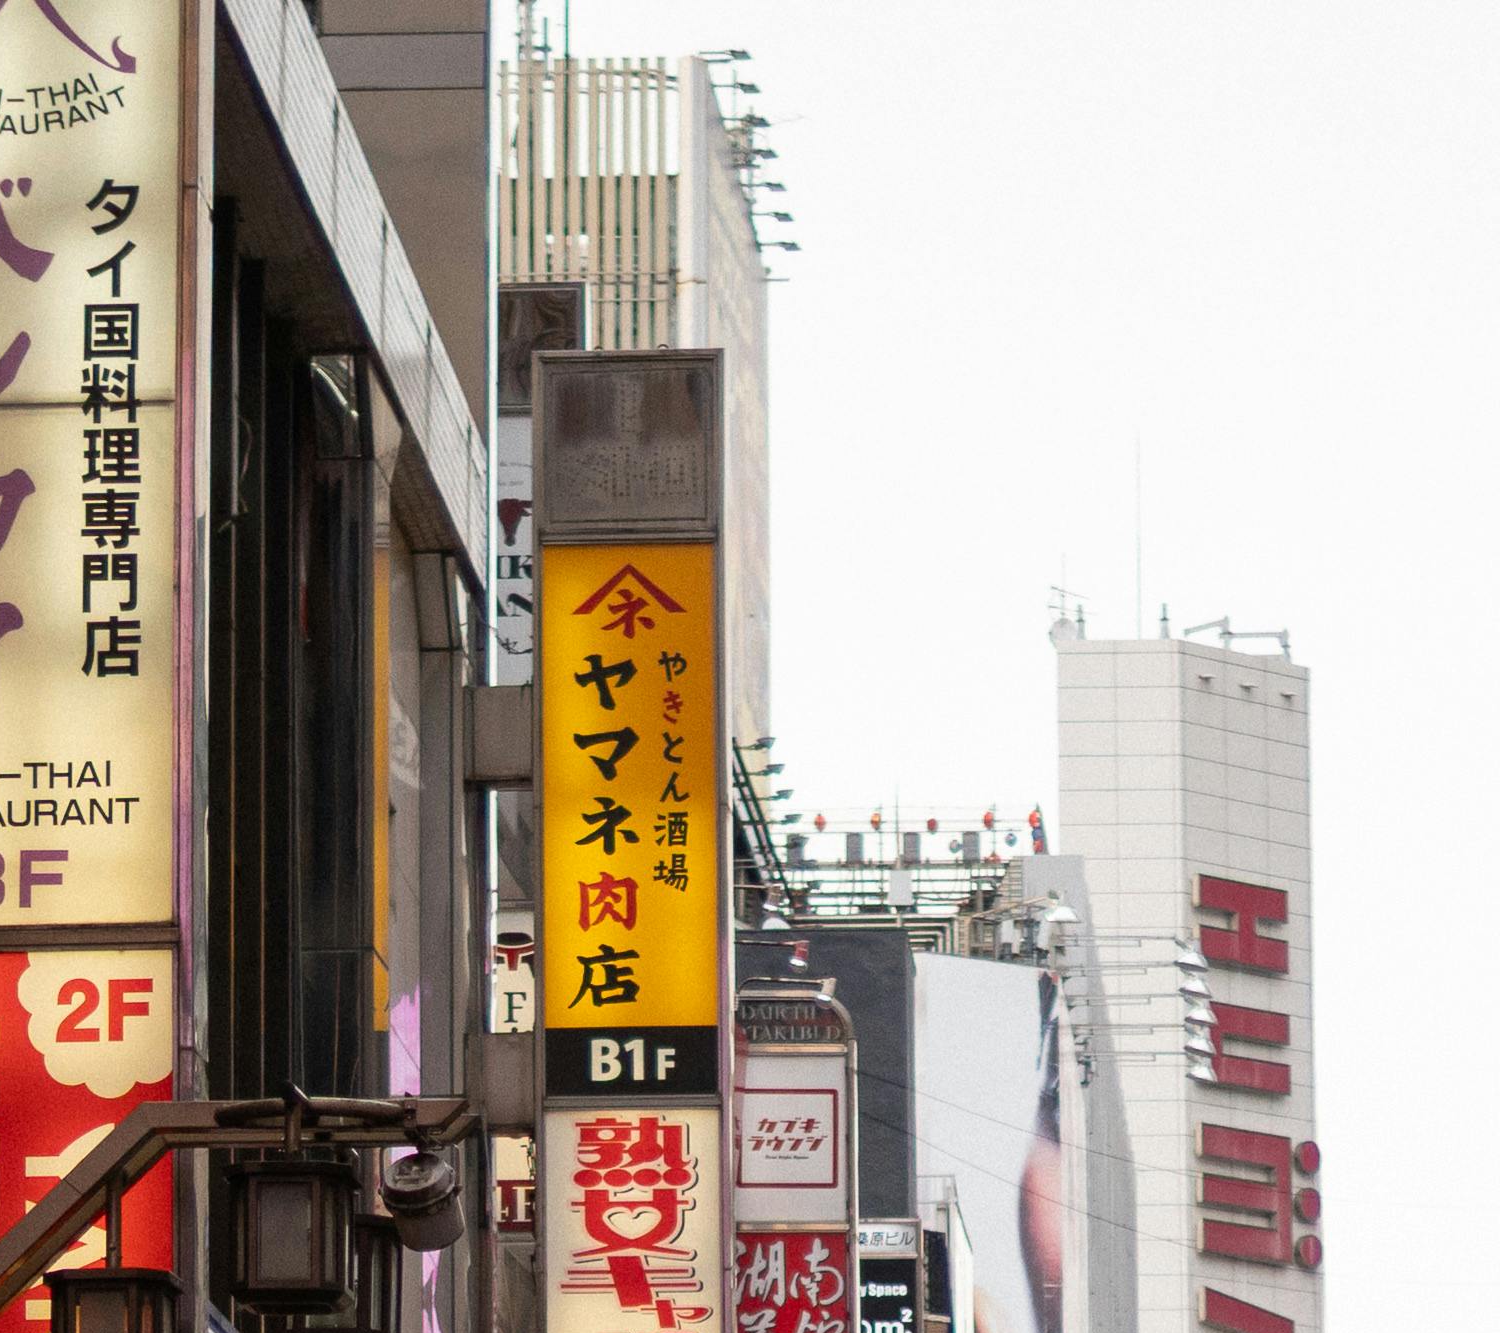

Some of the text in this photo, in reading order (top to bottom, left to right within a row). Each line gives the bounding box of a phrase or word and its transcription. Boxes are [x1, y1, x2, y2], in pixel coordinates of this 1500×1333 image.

[81, 178, 142, 679] タイ国料理専門店
[653, 650, 689, 893] やきとん酒場
[569, 654, 639, 1009] ヤマネ肉店
[56, 979, 154, 1042] 2F
[589, 1039, 676, 1081] B1F
[748, 1135, 828, 1151] ラウンジ
[757, 1117, 821, 1133] カブキ
[868, 1283, 908, 1298] Space
